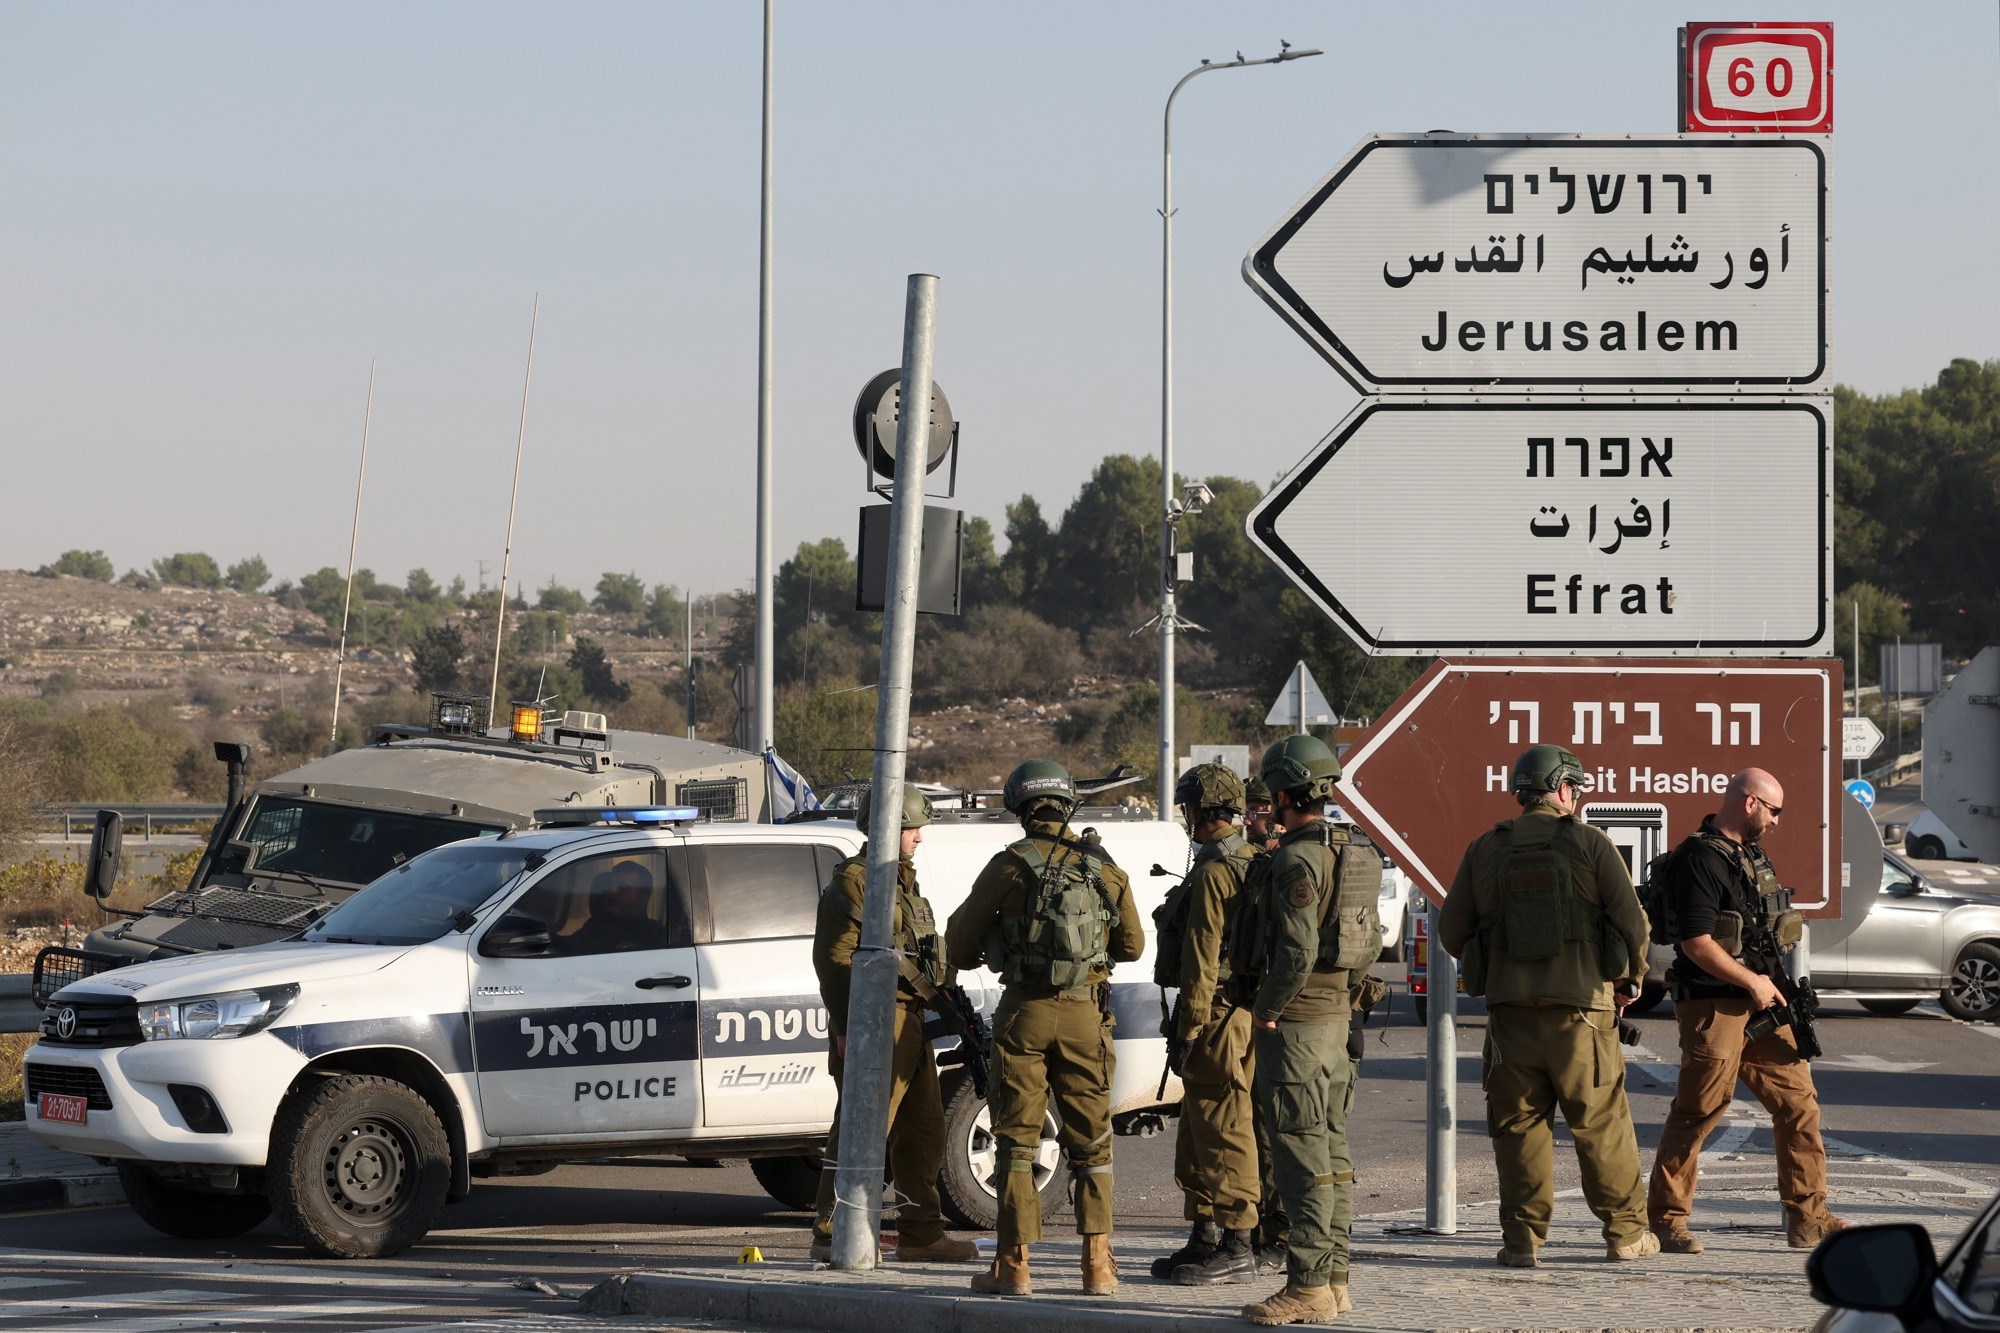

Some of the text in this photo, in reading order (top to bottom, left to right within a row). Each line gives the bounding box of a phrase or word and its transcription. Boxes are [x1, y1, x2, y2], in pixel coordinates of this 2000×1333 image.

[1727, 57, 1793, 98] 60
[1483, 166, 1712, 214] ירושלים
[1383, 233, 1544, 289] القدس
[1421, 310, 1738, 352] Jerusalem
[1526, 437, 1673, 478] אפרת
[1529, 497, 1670, 555] إفرات
[1526, 574, 1673, 614] Efrat
[1571, 701, 1663, 745] בית
[1695, 702, 1761, 746] הר
[1578, 766, 1735, 794] eit Hashe
[520, 1016, 657, 1059] ישראל
[574, 1076, 677, 1102] POLICE
[718, 1061, 816, 1092] الشرطة
